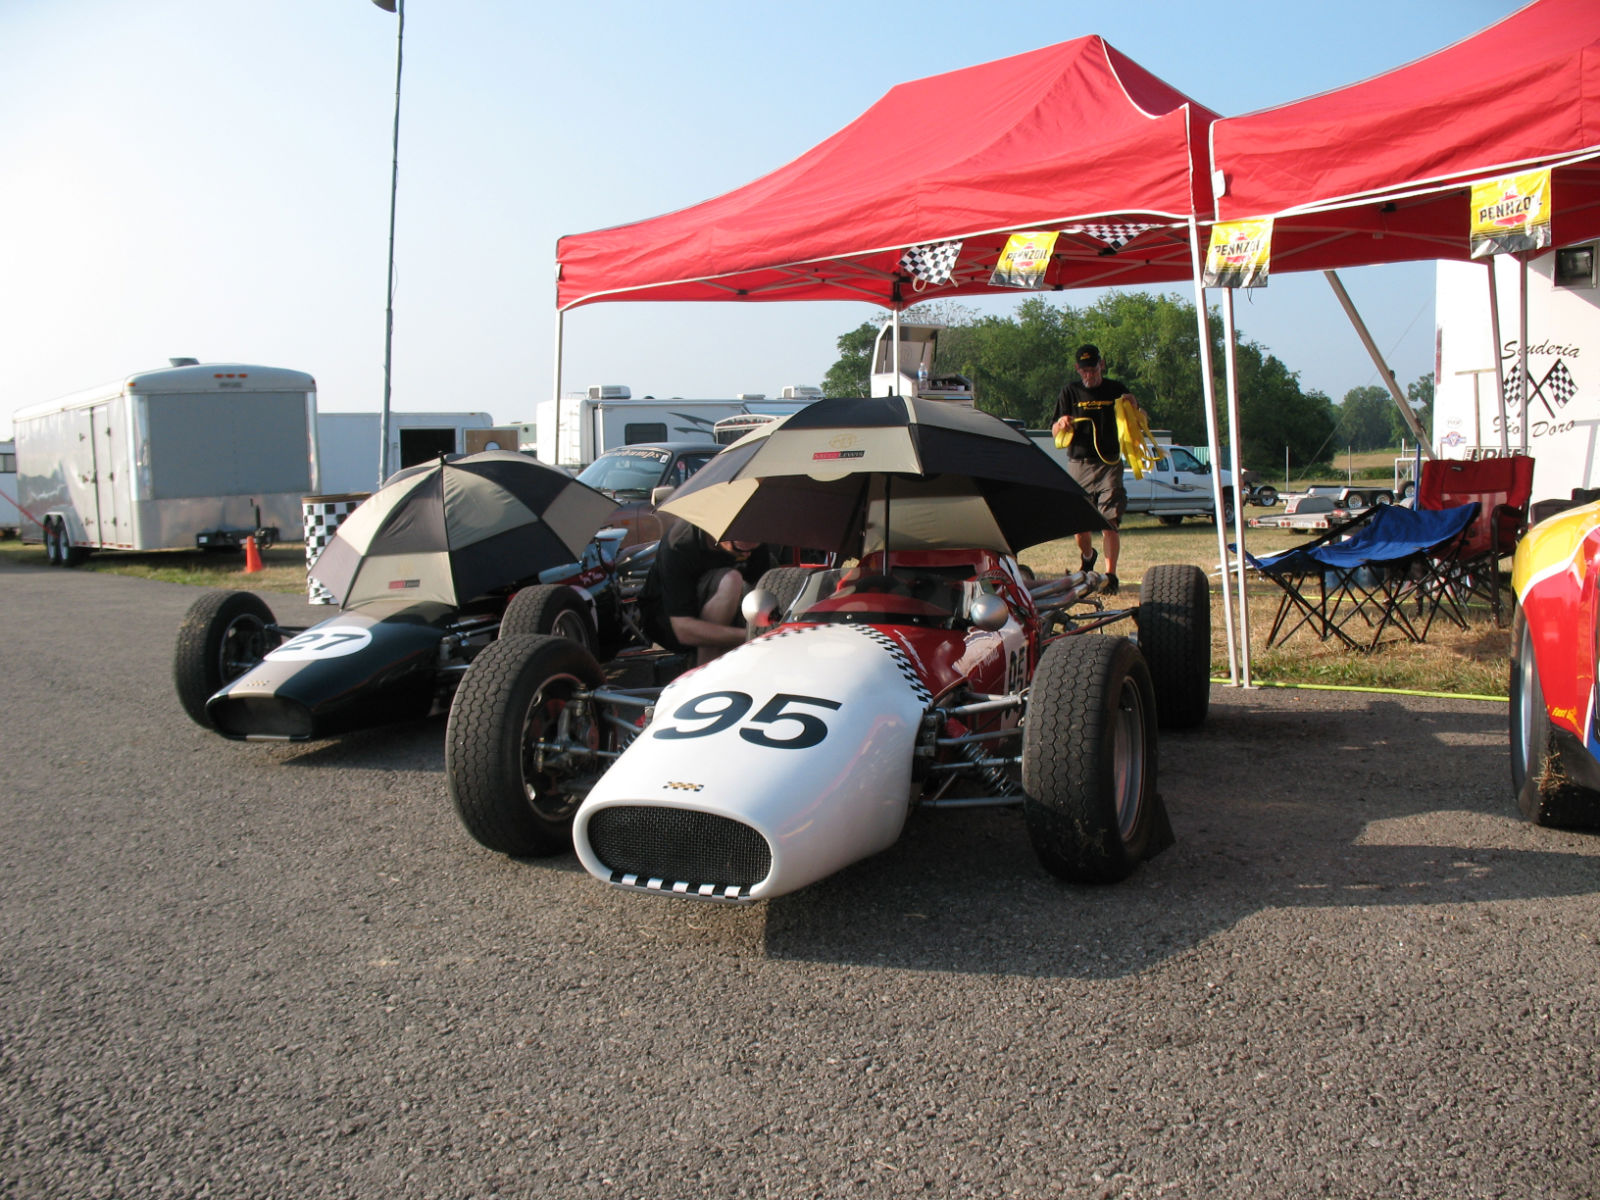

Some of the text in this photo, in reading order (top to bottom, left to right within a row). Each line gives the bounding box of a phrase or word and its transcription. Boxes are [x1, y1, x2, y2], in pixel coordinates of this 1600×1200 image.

[1479, 195, 1543, 222] PENNZO
[1214, 240, 1264, 256] PENNZOI
[272, 633, 366, 651] 27
[652, 690, 843, 750] 95
